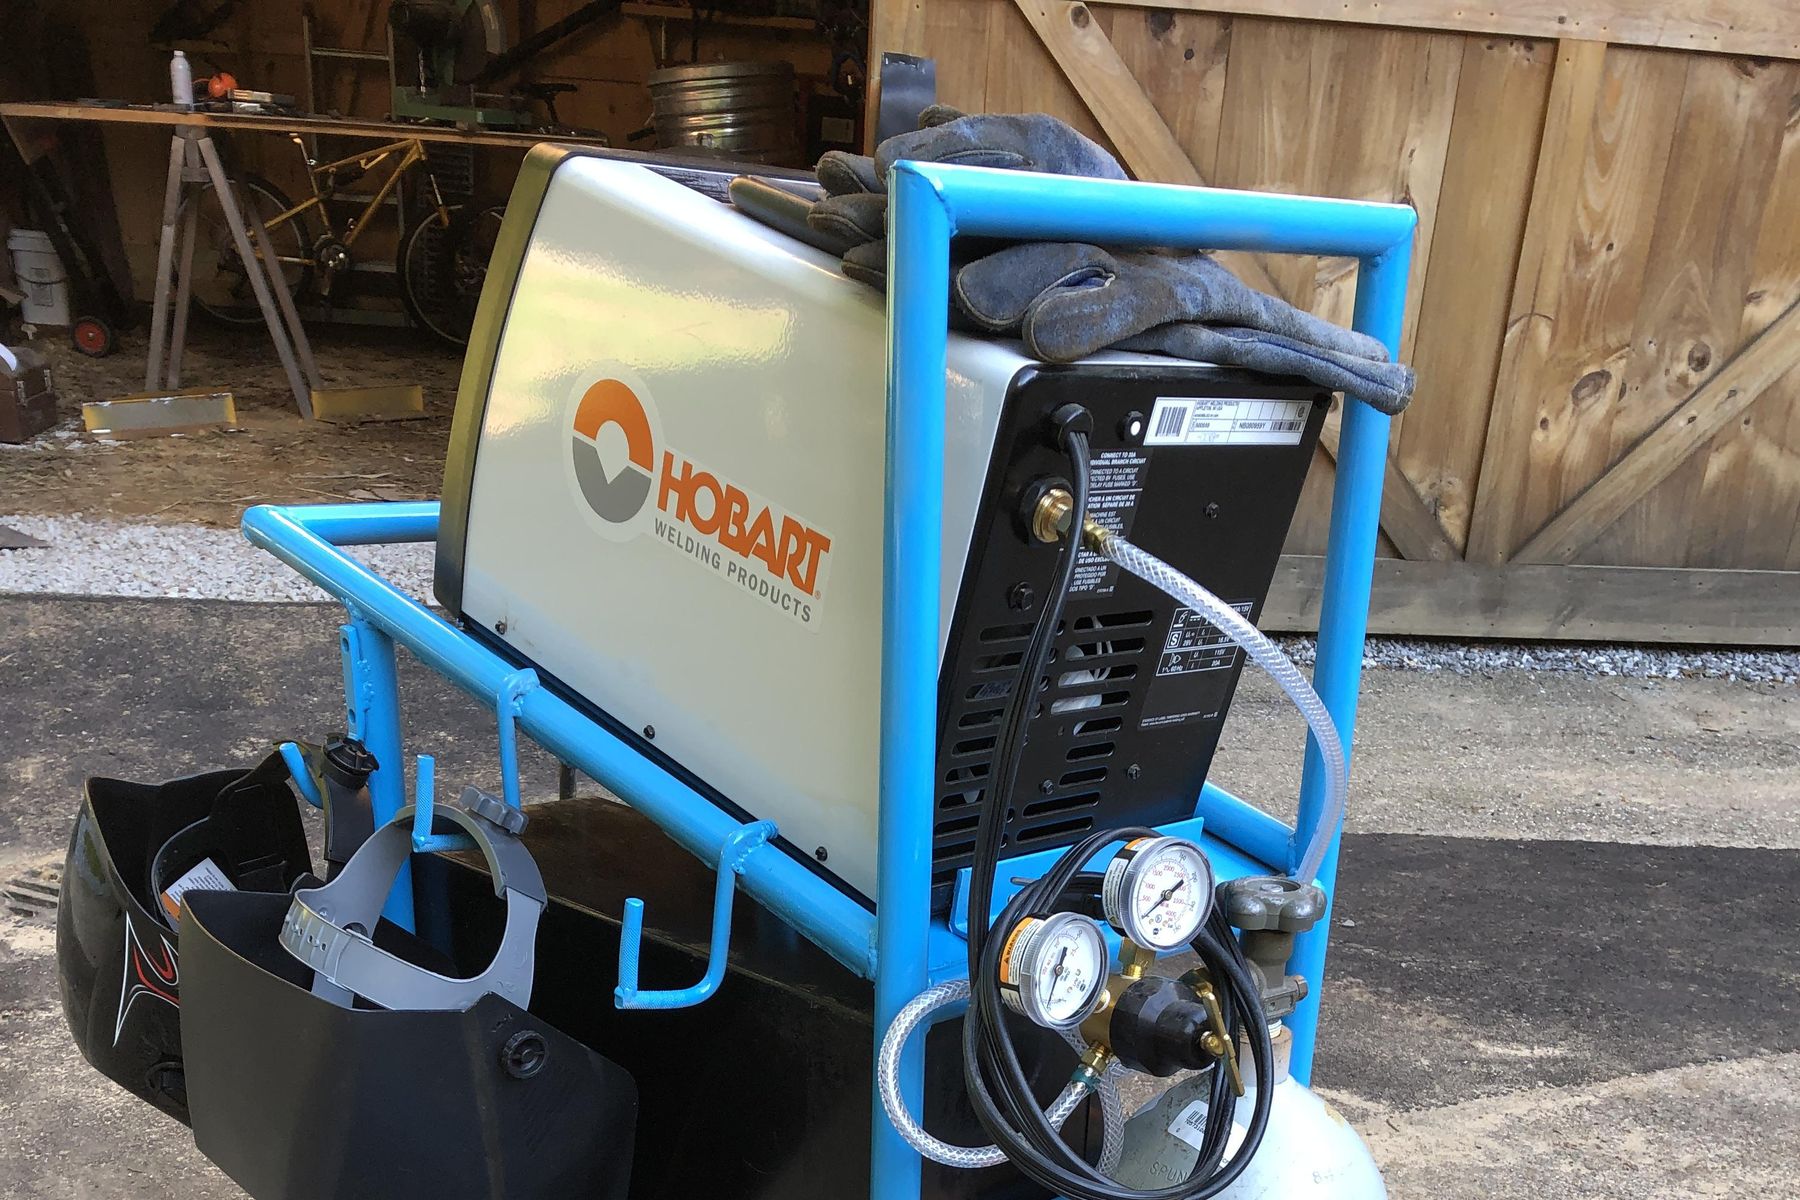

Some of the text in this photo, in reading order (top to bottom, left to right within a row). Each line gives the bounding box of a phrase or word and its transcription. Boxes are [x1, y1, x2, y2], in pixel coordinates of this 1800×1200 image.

[655, 517, 812, 623] WELDING PRODUCTS
[657, 449, 831, 596] HOBART
